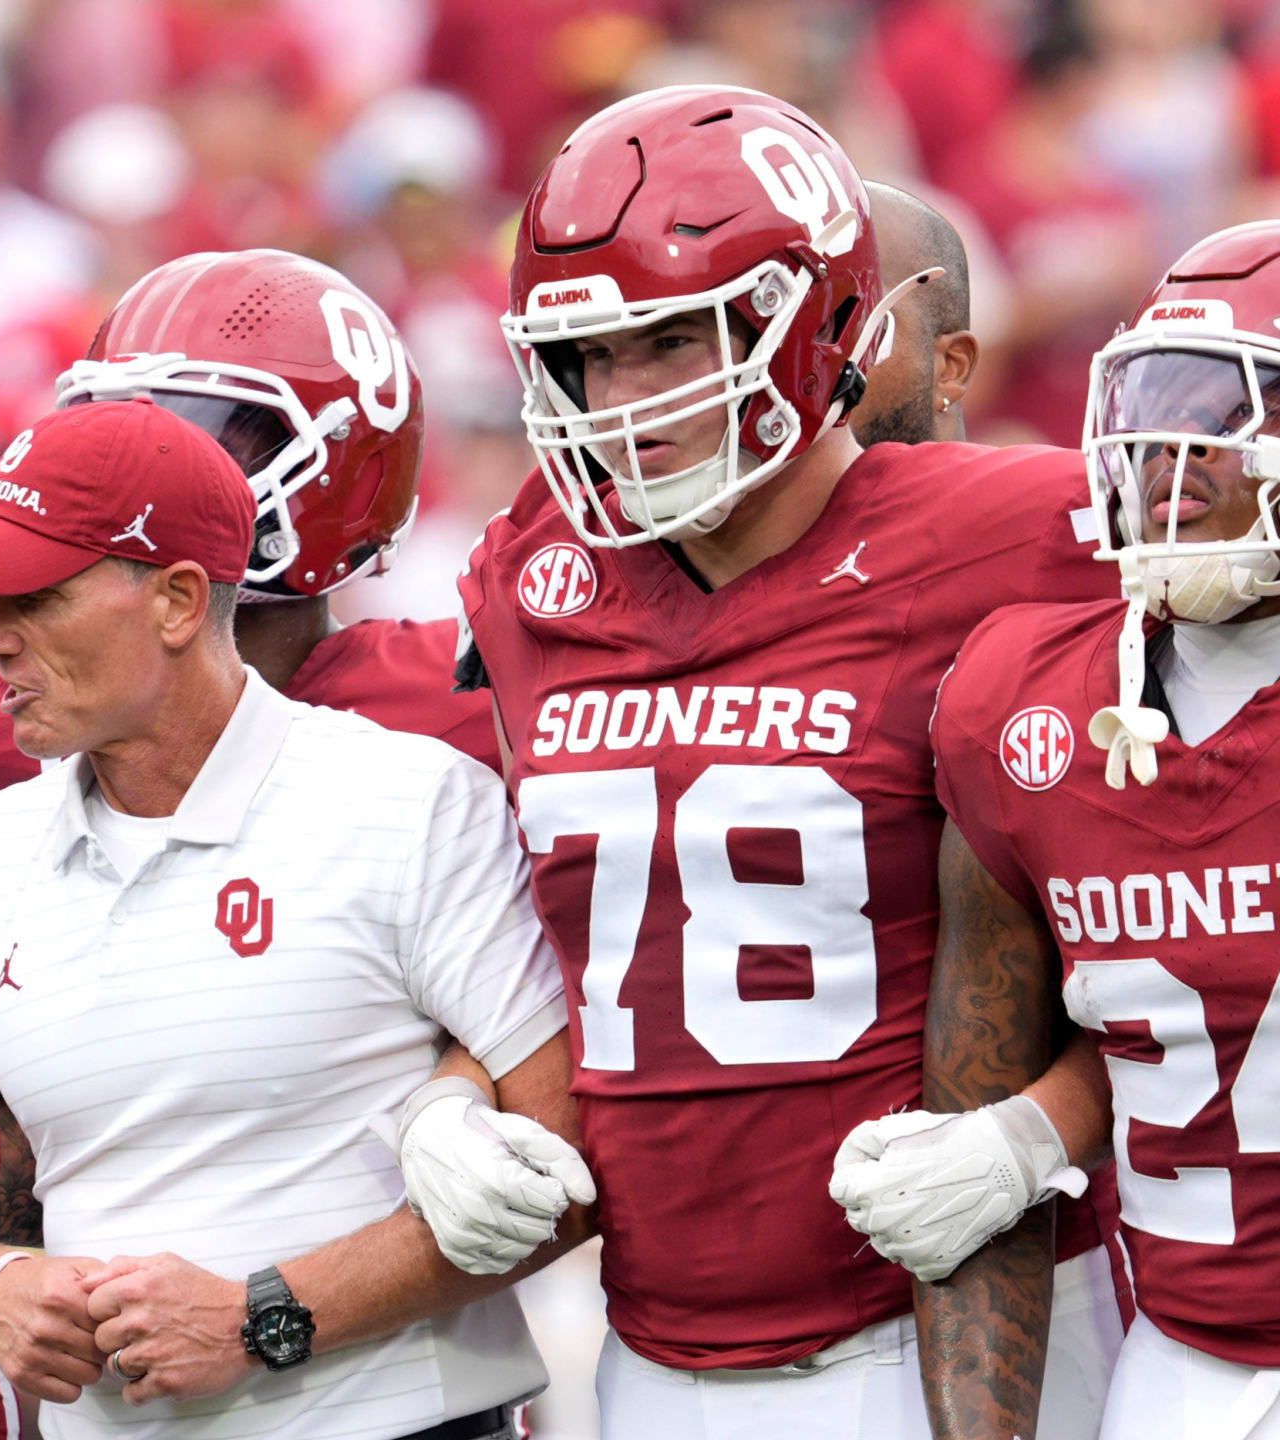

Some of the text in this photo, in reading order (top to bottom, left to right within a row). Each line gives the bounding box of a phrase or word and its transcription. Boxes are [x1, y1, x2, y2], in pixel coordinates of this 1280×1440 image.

[537, 287, 593, 308] OKLAHOMA
[1151, 306, 1207, 321] OKLAHOMA
[319, 289, 410, 432] OU
[523, 546, 593, 613] SEC
[533, 686, 857, 756] SOONERS
[1006, 711, 1070, 785] SEC
[215, 877, 274, 958] OU
[519, 764, 878, 1071] 78
